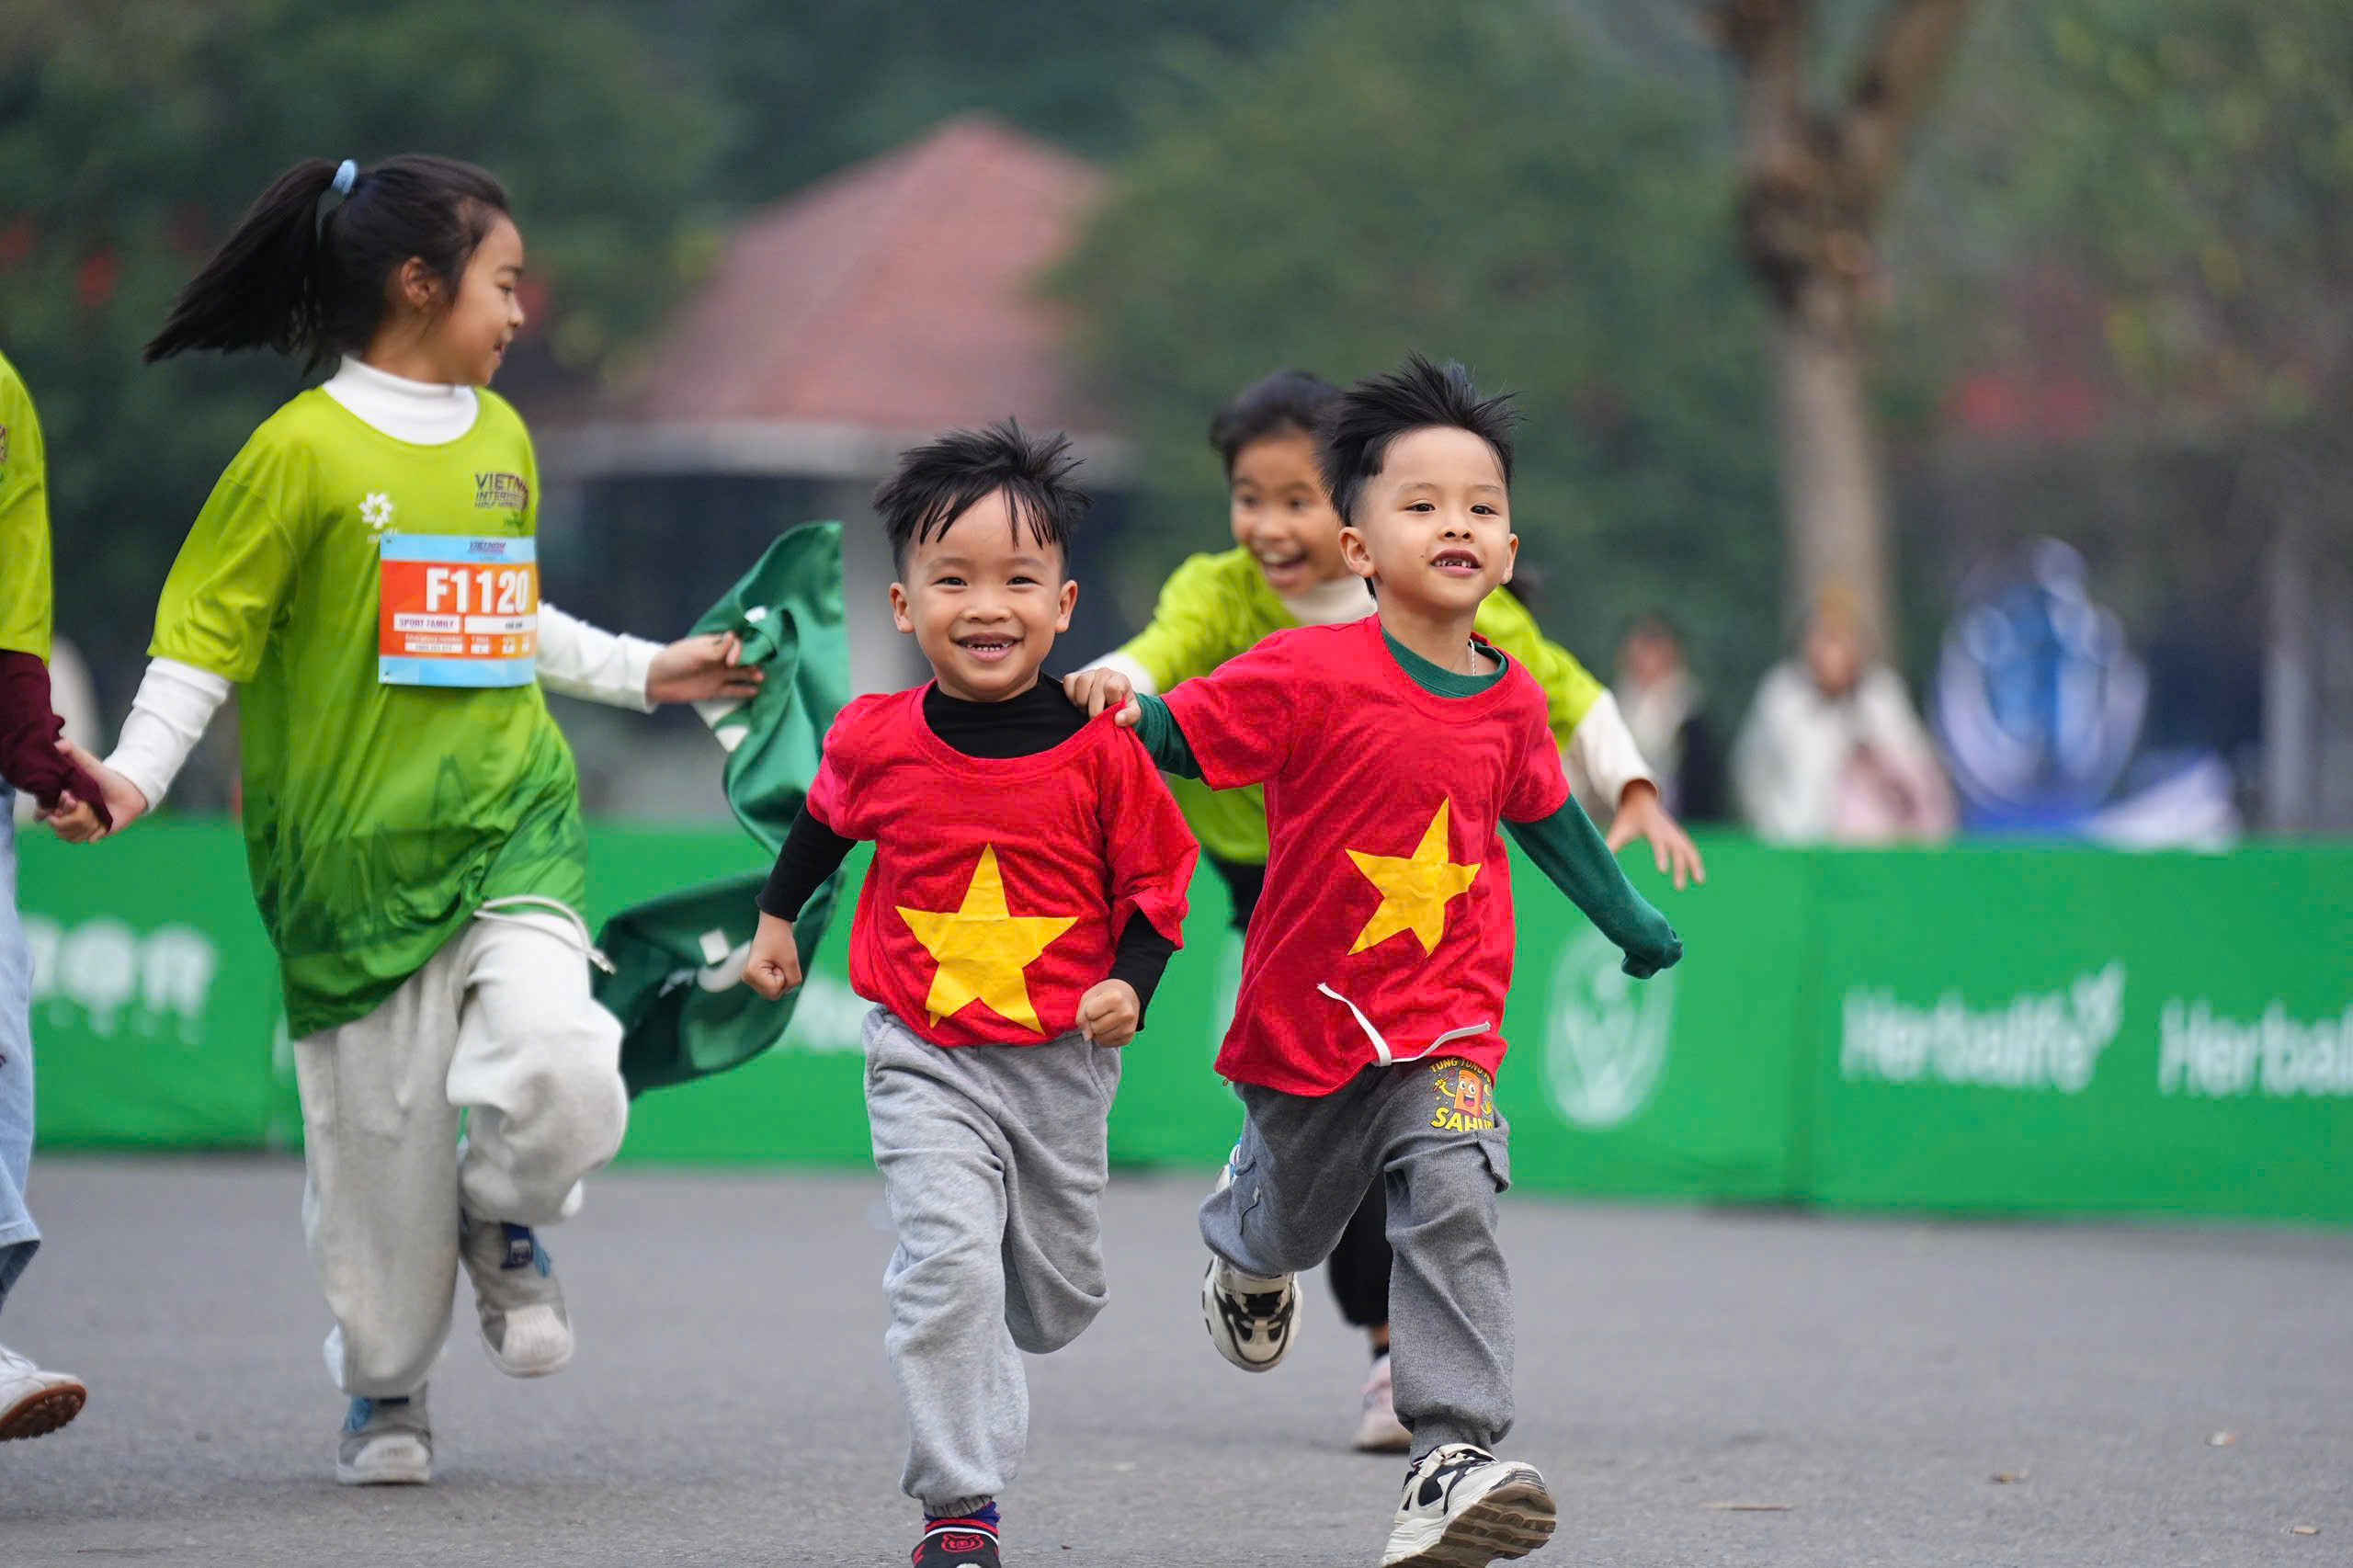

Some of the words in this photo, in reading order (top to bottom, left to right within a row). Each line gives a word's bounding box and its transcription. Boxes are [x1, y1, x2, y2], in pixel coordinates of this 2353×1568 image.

[426, 567, 529, 614] F1120
[1430, 1058, 1459, 1073] TUNG
[2156, 993, 2353, 1097] Herbal
